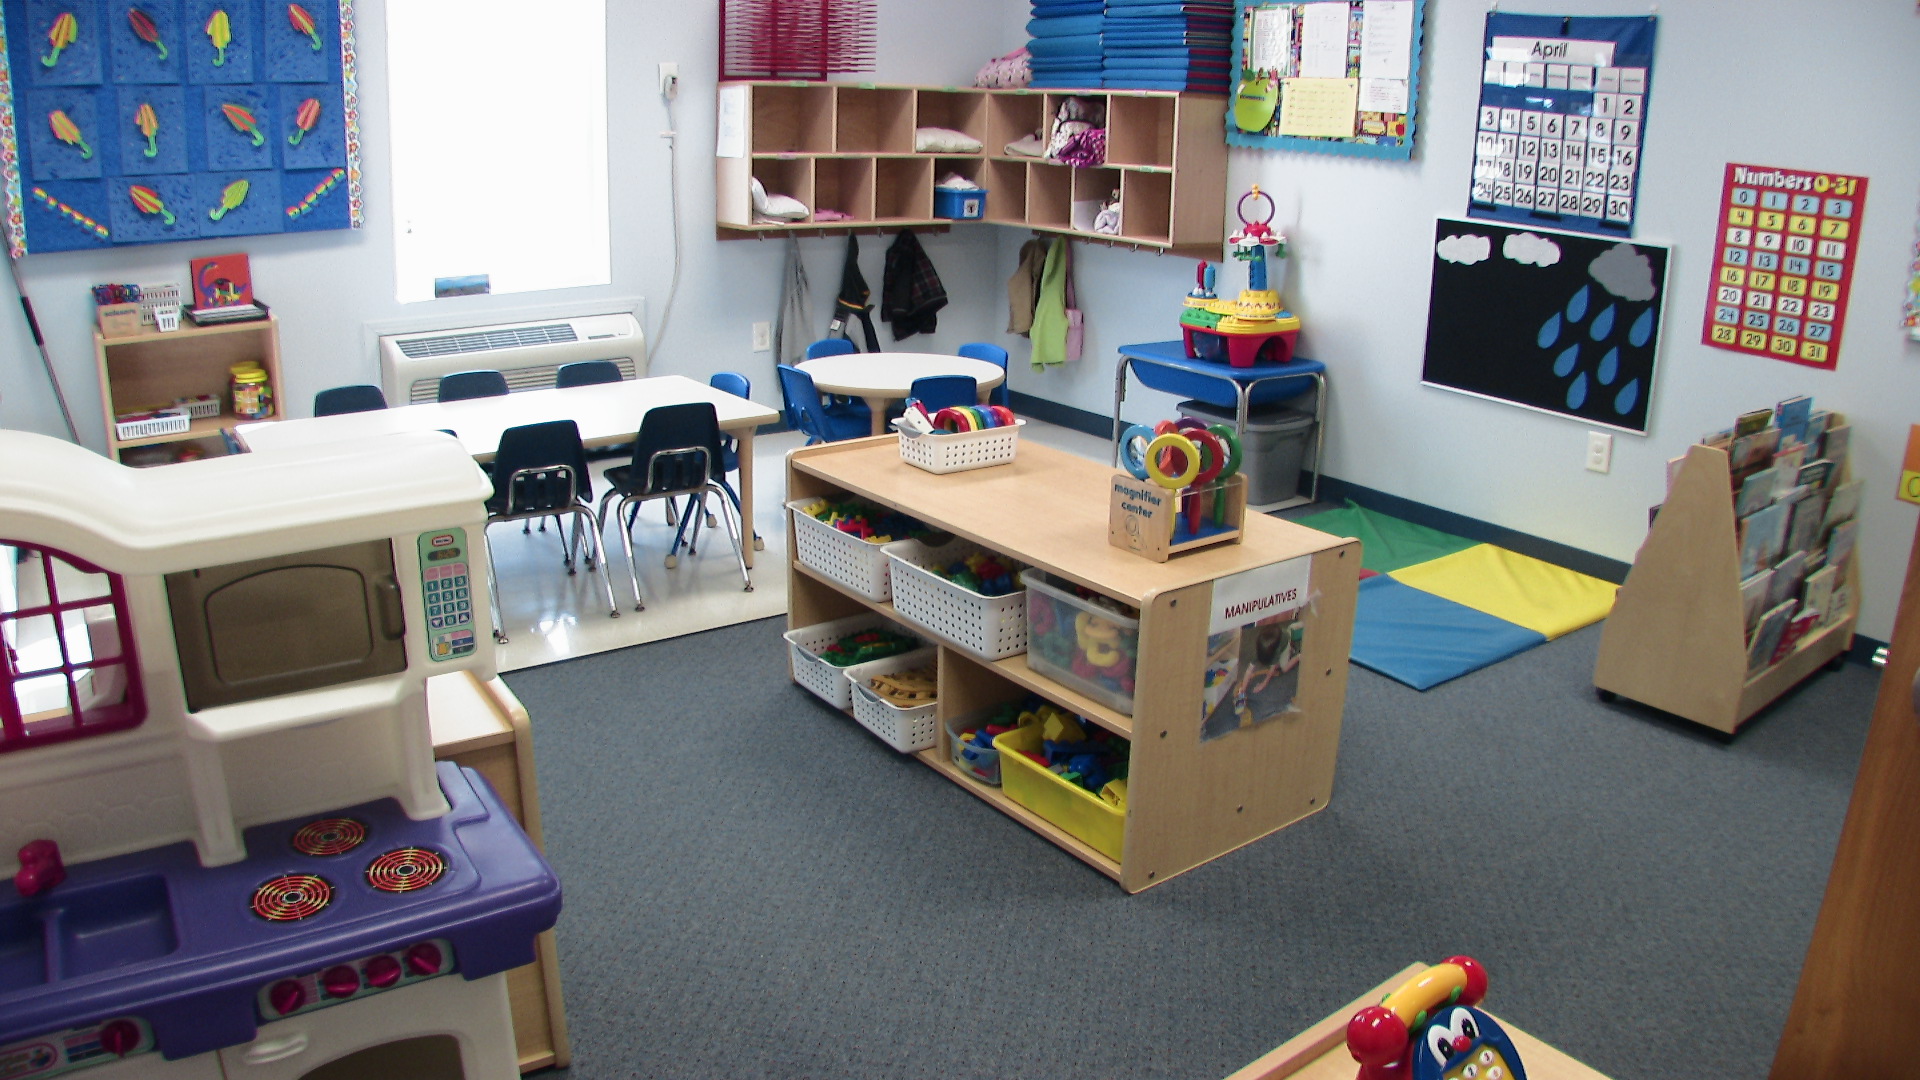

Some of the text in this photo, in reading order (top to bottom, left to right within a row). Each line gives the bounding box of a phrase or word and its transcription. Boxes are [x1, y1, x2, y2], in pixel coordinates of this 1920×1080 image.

[1531, 40, 1569, 60] April
[1602, 97, 1634, 115] 1 2
[1485, 110, 1495, 126] 3
[1526, 115, 1536, 131] 5
[1547, 118, 1557, 134] 6
[1571, 120, 1581, 136] 7
[1595, 122, 1605, 138] 8
[1621, 125, 1631, 141] 9
[1502, 138, 1514, 154] 11
[1522, 140, 1536, 156] 12
[1543, 142, 1558, 158] 13
[1566, 145, 1581, 161] 14
[1591, 147, 1607, 163] 15
[1616, 149, 1633, 166] 16
[1498, 161, 1512, 177] 18
[1518, 163, 1533, 179] 19
[1540, 166, 1557, 182] 20
[1564, 169, 1580, 185] 21
[1585, 171, 1605, 188] 22
[1610, 174, 1629, 191] 23
[1733, 167, 1812, 191] Numbers
[1495, 185, 1512, 201] 25
[1515, 188, 1532, 204] 26
[1538, 191, 1556, 207] 27
[1561, 194, 1578, 210] 28
[1583, 197, 1601, 213] 29
[1609, 200, 1629, 217] 30
[1740, 190, 1842, 215] 0 1 2 3
[1737, 210, 1840, 235] 4 5 6 7
[1734, 231, 1837, 256] 8 9 10 11
[1729, 250, 1834, 277] 12 13 14 15
[1726, 270, 1831, 297] 16 17 18 19
[1722, 289, 1830, 318] 20 21 22 23
[1719, 308, 1827, 338] 24 25 26 27
[1746, 333, 1761, 346] 29
[1807, 345, 1822, 359] 31
[1115, 484, 1161, 506] magnifier
[1121, 501, 1153, 519] center
[443, 580, 450, 588] 2
[1225, 588, 1297, 619] MANIPULATIVES
